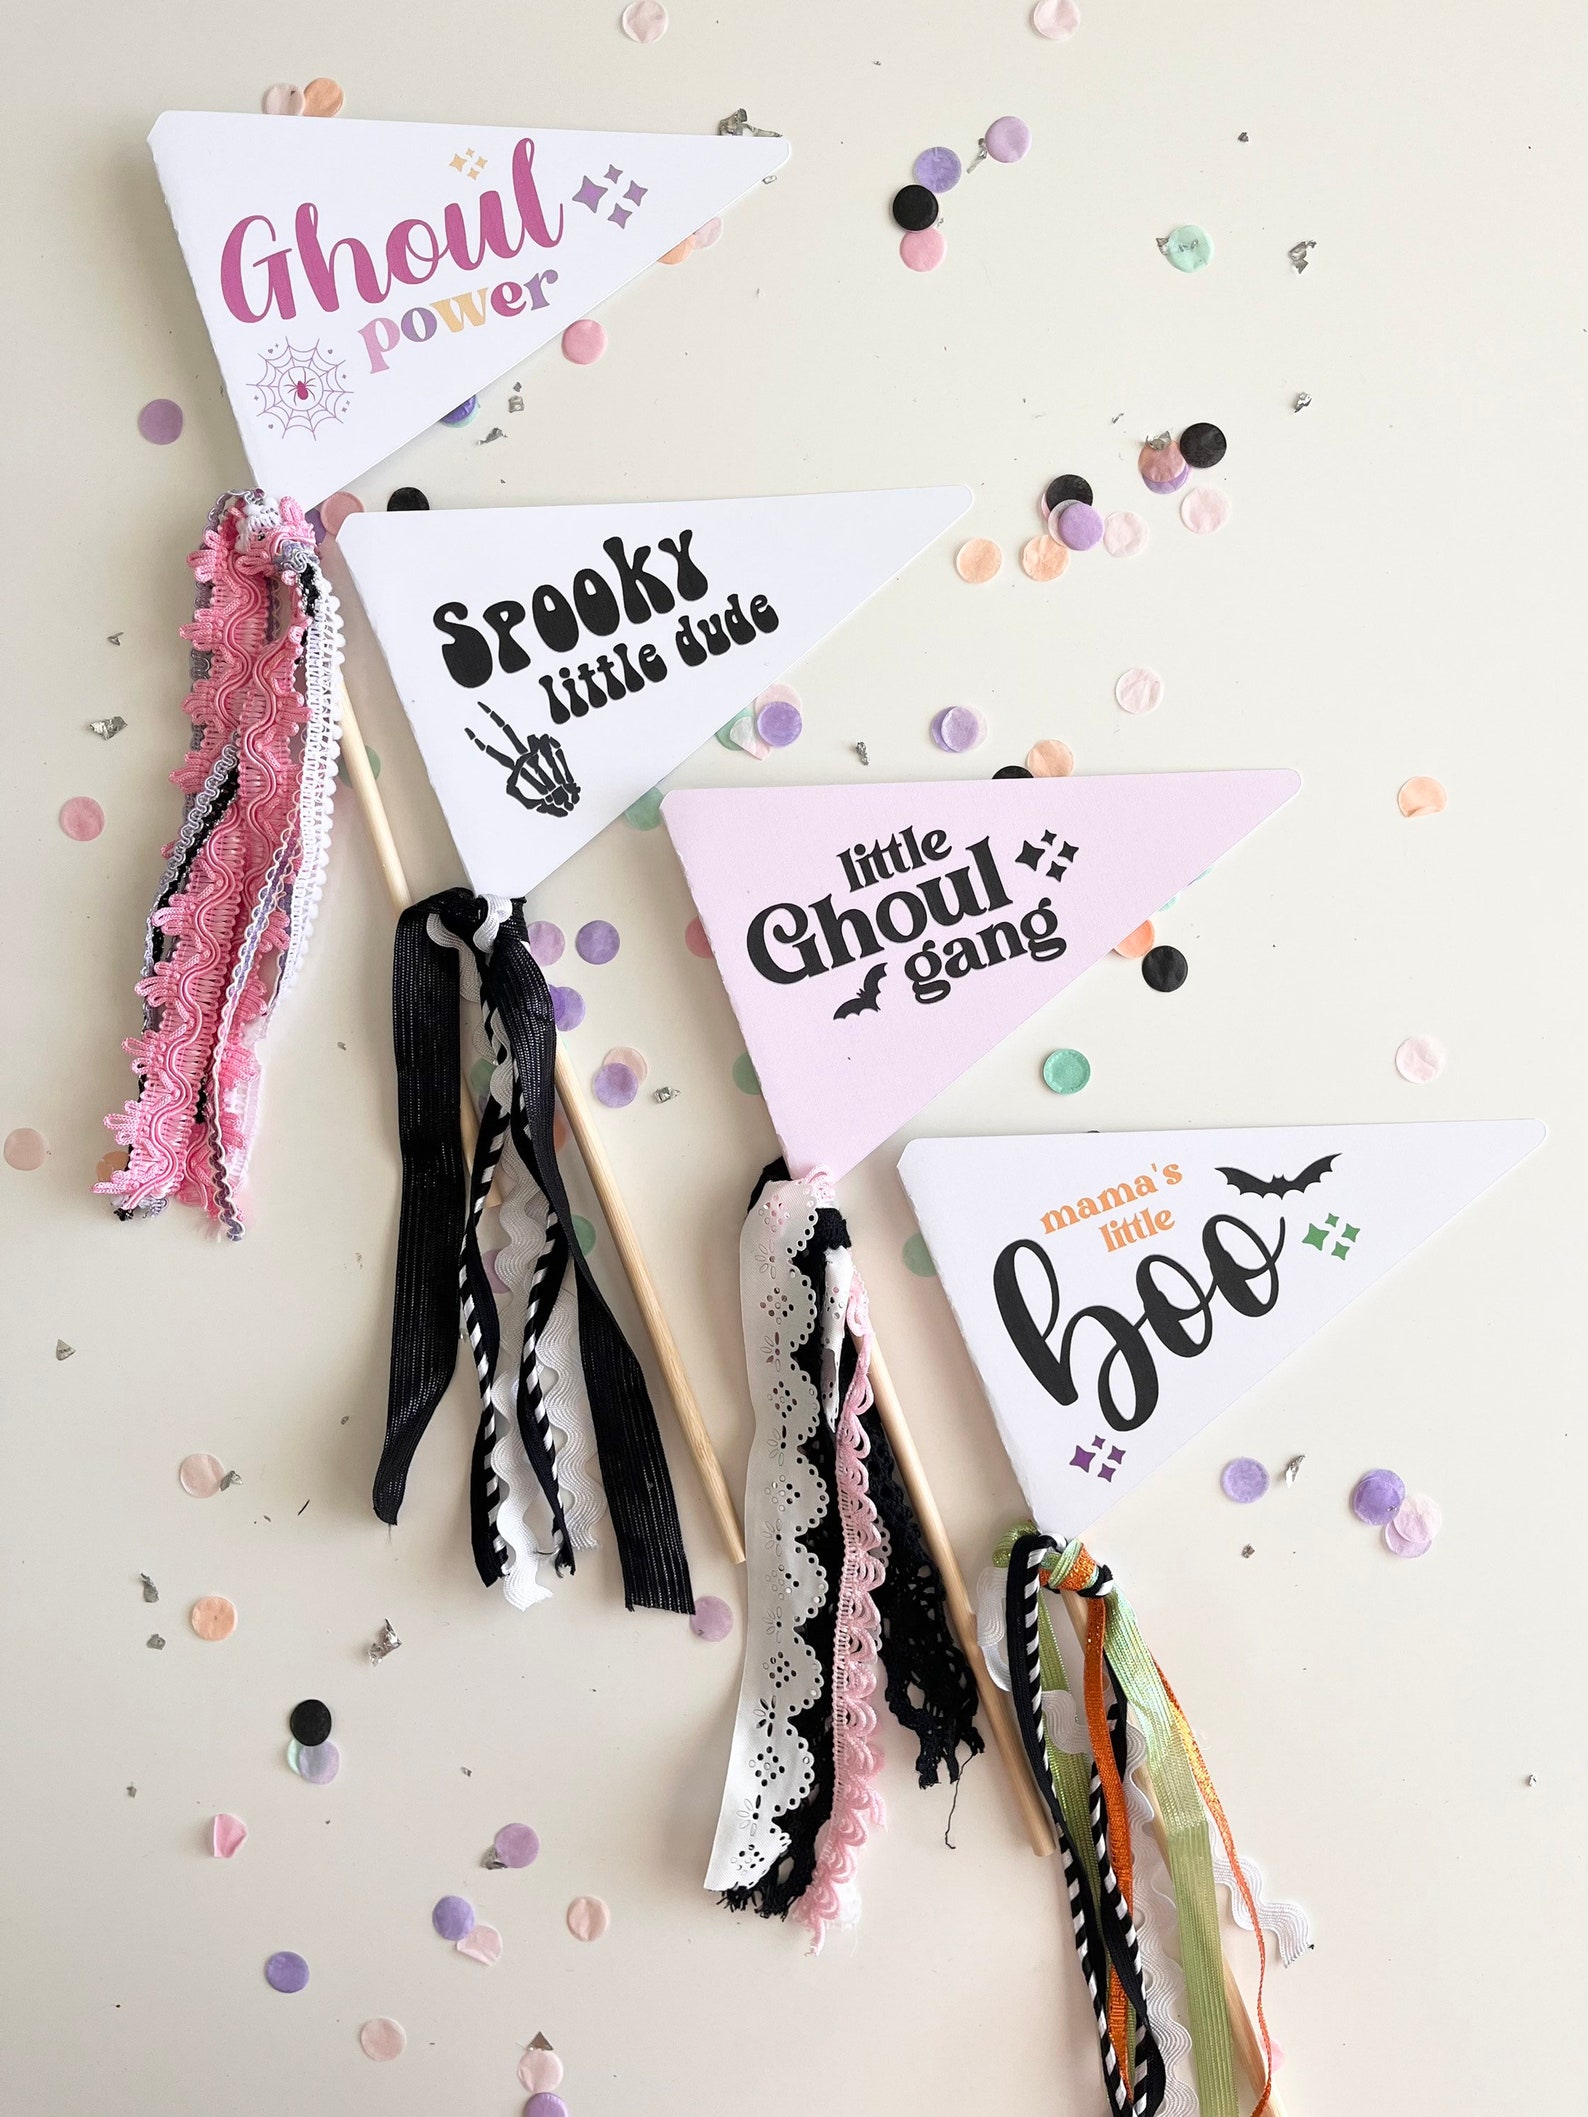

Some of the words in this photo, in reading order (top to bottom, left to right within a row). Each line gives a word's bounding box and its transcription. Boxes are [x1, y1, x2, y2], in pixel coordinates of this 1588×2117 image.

[220, 138, 564, 324] Ghoul
[358, 269, 559, 374] power
[539, 643, 668, 725] little
[675, 594, 780, 667] dude
[746, 835, 1014, 985] Ghoul
[836, 825, 952, 893] little
[904, 897, 1067, 1005] gang
[1039, 1162, 1184, 1235] mama's
[1098, 1207, 1176, 1253] little
[993, 1214, 1286, 1432] boo
